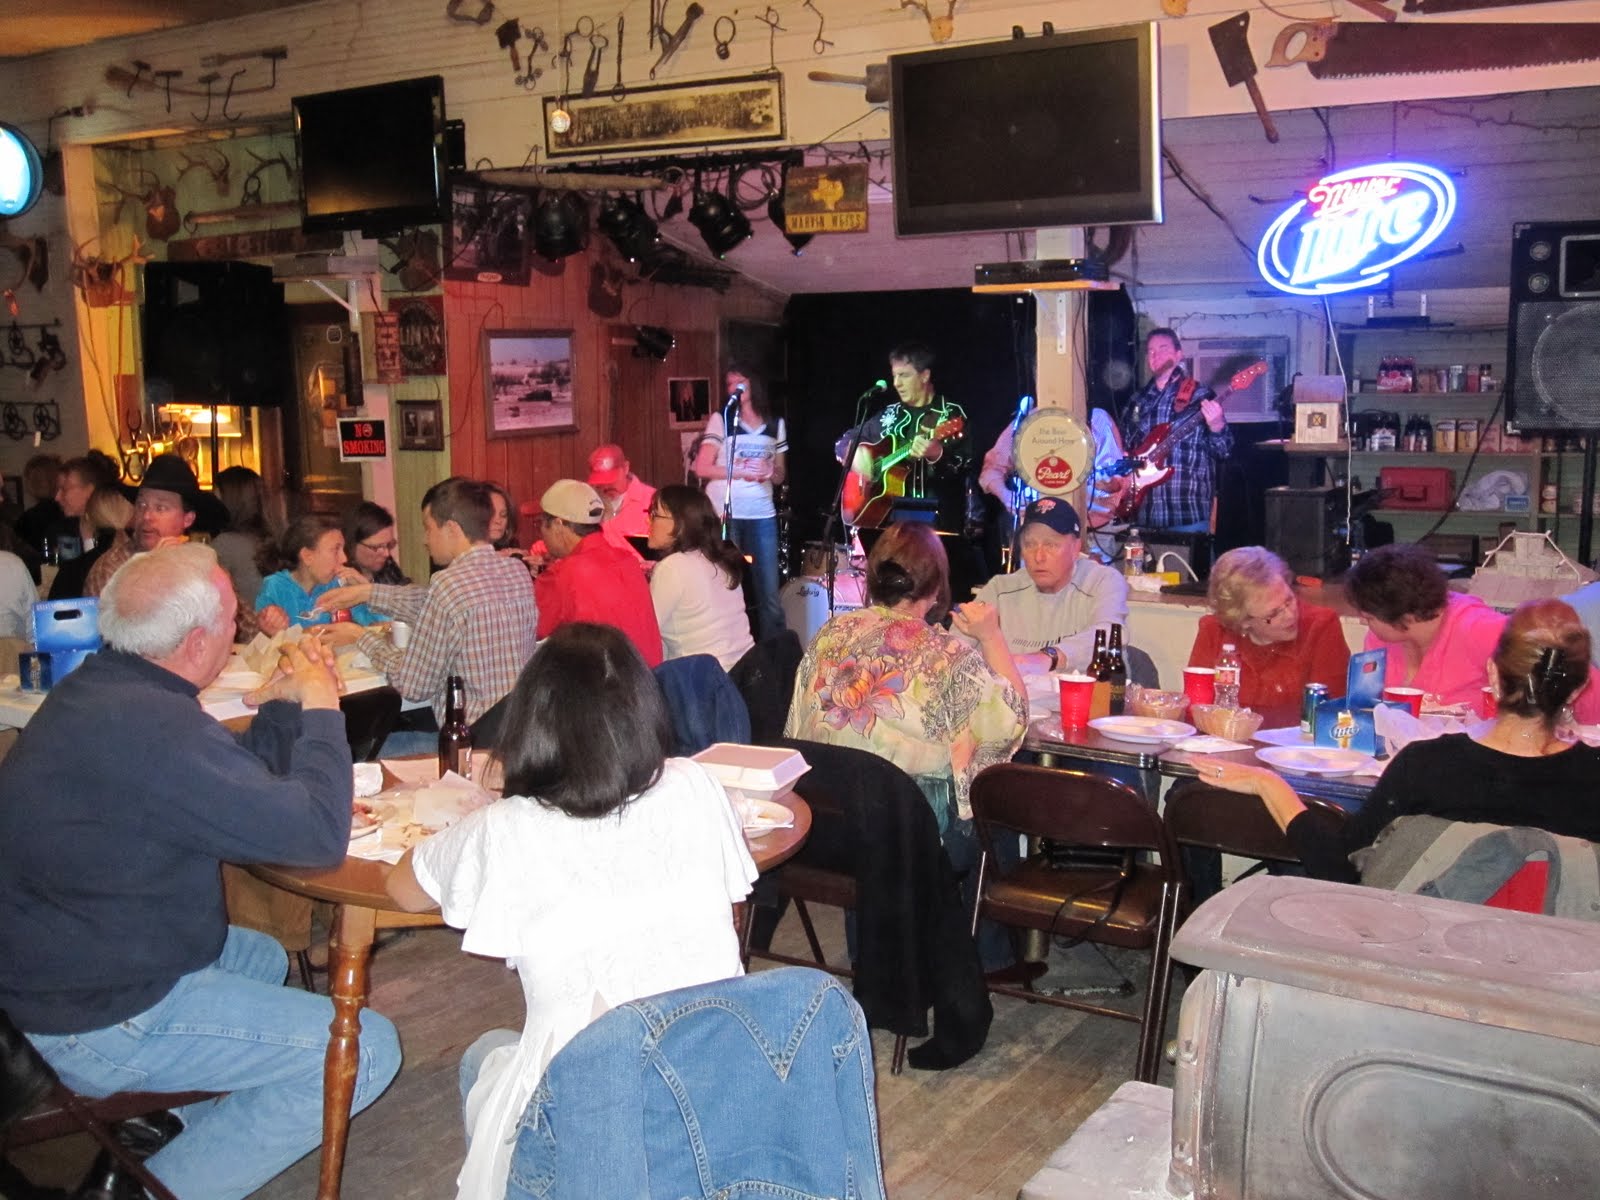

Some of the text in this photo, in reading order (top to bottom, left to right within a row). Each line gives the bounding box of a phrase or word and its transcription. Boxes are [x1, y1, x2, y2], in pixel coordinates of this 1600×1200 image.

[1290, 191, 1430, 285] Lite
[399, 325, 441, 345] LIMAX
[354, 423, 373, 438] NO
[343, 440, 385, 454] SMOKING
[1037, 466, 1071, 480] Pearl
